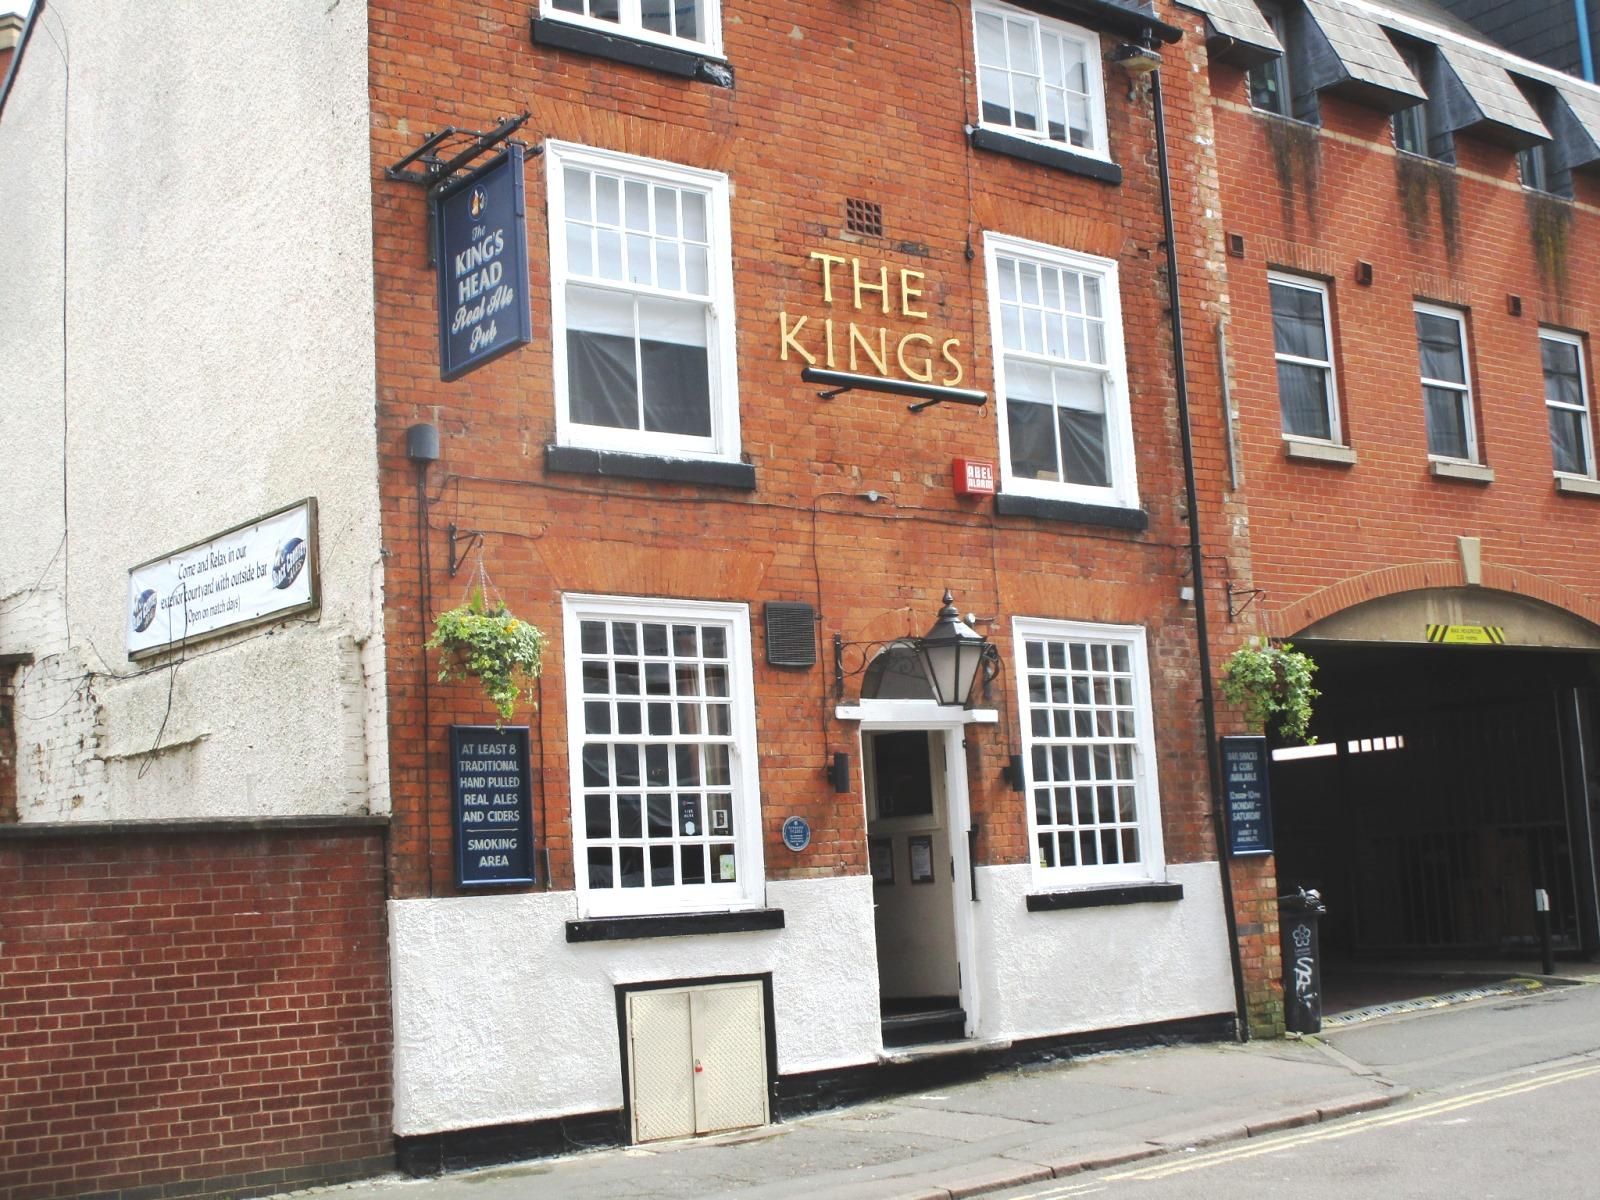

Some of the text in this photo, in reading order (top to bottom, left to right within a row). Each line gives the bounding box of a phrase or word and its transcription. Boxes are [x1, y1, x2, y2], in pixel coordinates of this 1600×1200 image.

[471, 225, 486, 241] The
[458, 261, 503, 306] HEAD
[810, 251, 928, 319] THE
[451, 284, 514, 335] Real Ale
[469, 319, 498, 354] Pub
[779, 311, 964, 387] KINGS
[968, 465, 992, 479] ABEL
[178, 545, 247, 580] Come and Relax in our
[184, 577, 215, 603] courtyard
[215, 572, 230, 592] with
[230, 566, 255, 587] outside
[256, 561, 268, 579] bar
[202, 607, 210, 619] on
[210, 599, 226, 617] match
[226, 593, 241, 613] days)
[461, 743, 517, 756] AT LEAST 8
[459, 760, 519, 772] TRADITIONAL
[460, 776, 520, 789] HAND PULLED
[464, 793, 519, 806] REAL ALES
[1231, 801, 1255, 811] MONDAY
[463, 810, 520, 823] AND CIDERS
[1232, 811, 1261, 821] SATURDAY
[467, 838, 518, 851] SMOKING
[478, 855, 509, 868] AREA
